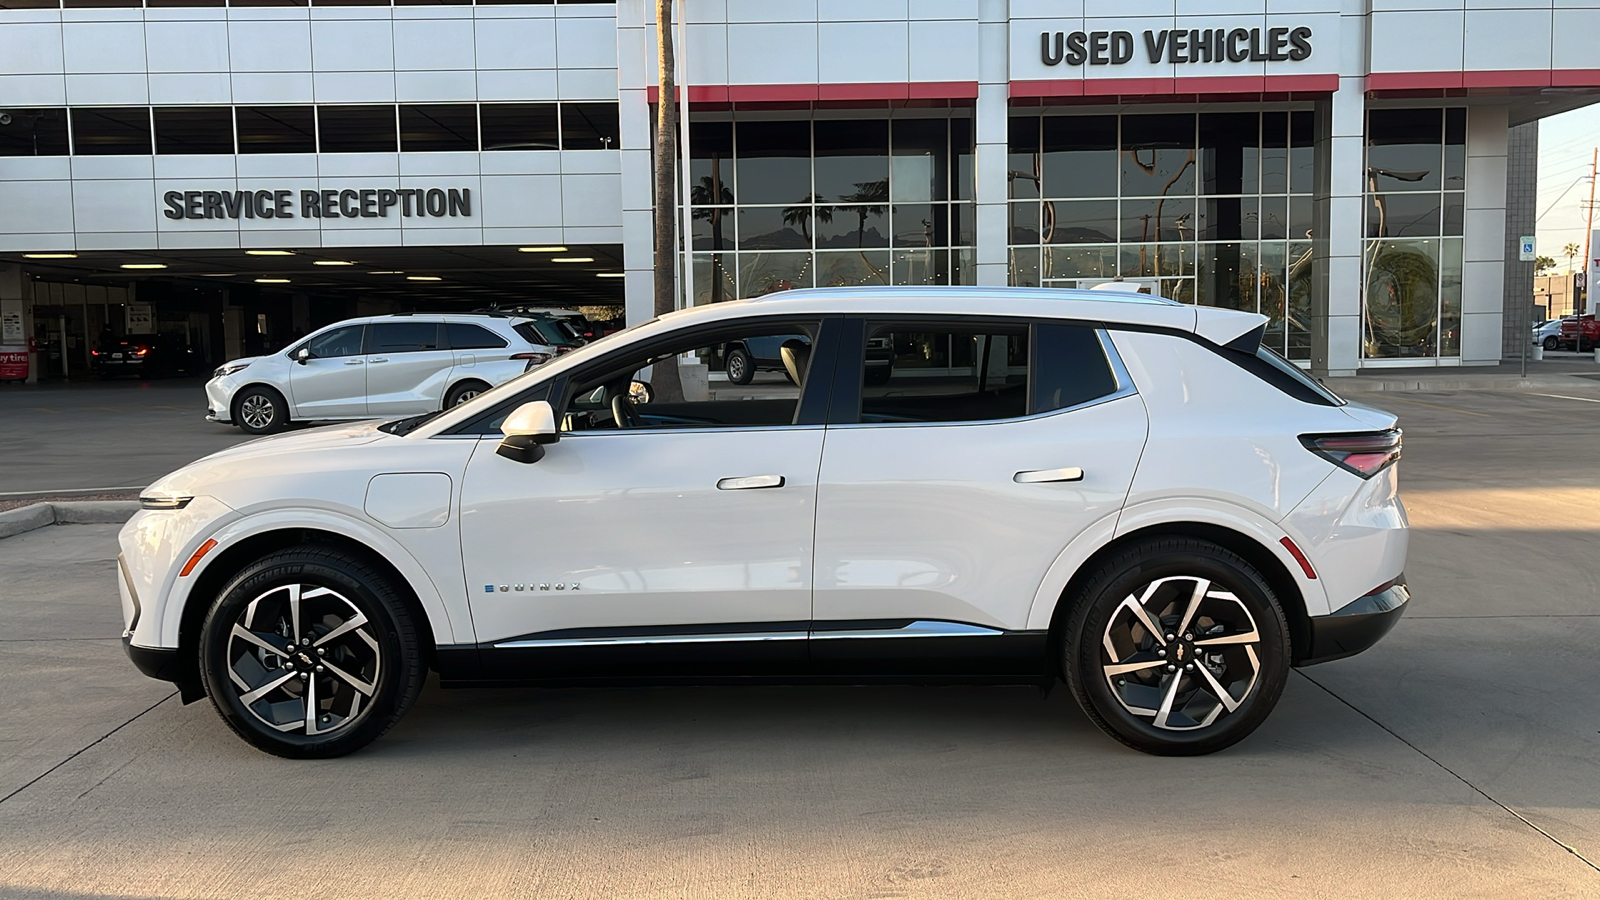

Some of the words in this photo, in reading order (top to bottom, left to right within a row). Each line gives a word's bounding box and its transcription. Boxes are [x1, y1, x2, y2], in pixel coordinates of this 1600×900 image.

[1041, 31, 1134, 66] USED
[1144, 27, 1312, 64] VEHICLES
[163, 190, 293, 219] SERVICE
[300, 188, 471, 218] RECEPTION
[484, 582, 580, 593] EQUINOX
